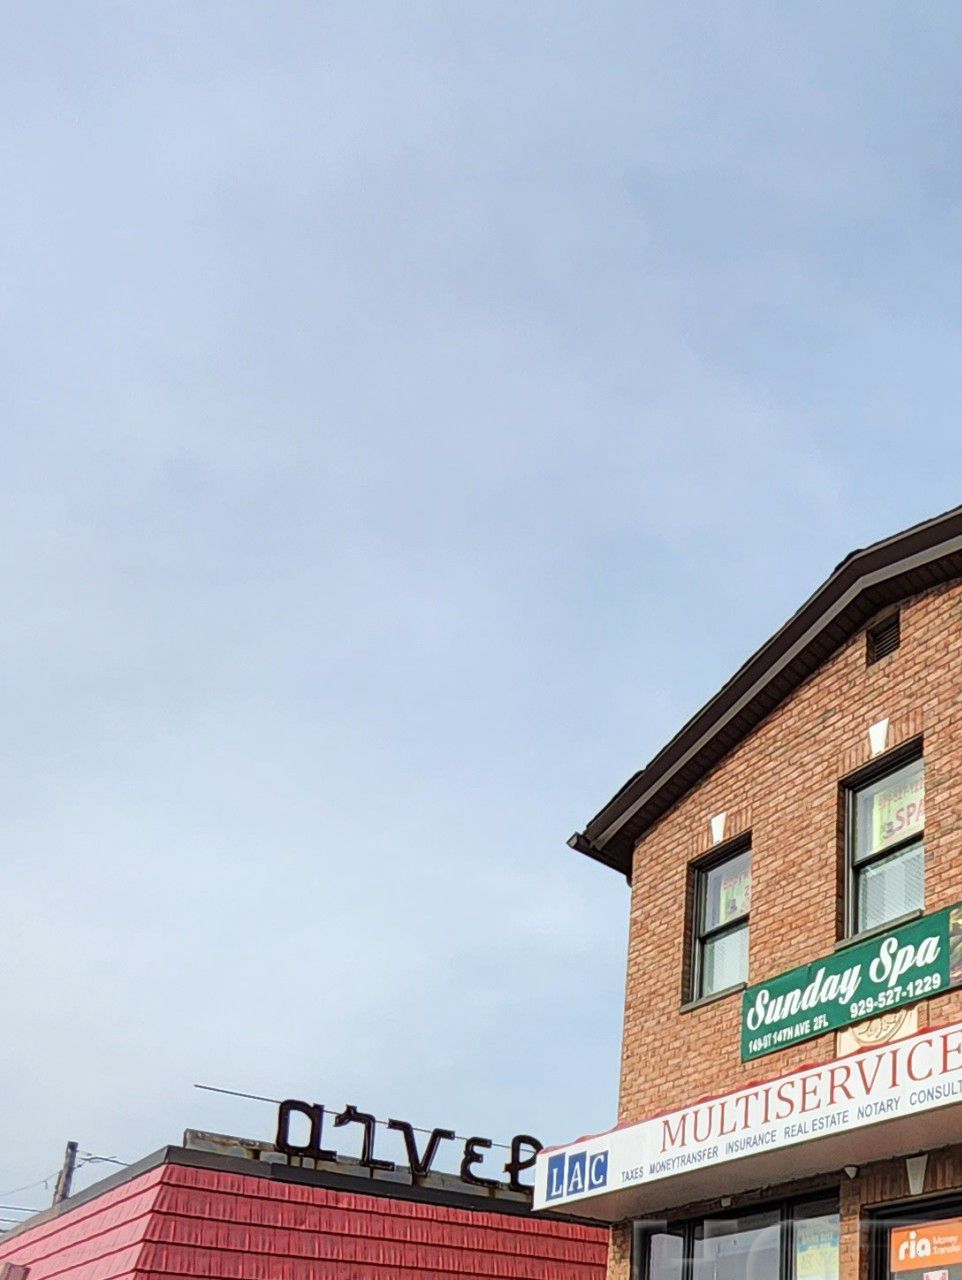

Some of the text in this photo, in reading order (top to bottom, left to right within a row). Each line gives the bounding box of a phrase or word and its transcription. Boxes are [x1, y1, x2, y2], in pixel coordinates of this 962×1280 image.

[747, 935, 941, 1031] Sunday Spa
[850, 973, 942, 1018] 929-527-1229
[813, 1013, 829, 1031] 2FL
[621, 1165, 644, 1183] TAXES
[650, 1145, 719, 1175] MONEYTRANSFER
[725, 1129, 777, 1153] INSURANCE
[857, 1096, 901, 1120] NOTARY
[550, 1153, 605, 1197] LAC
[898, 1230, 932, 1261] ria
